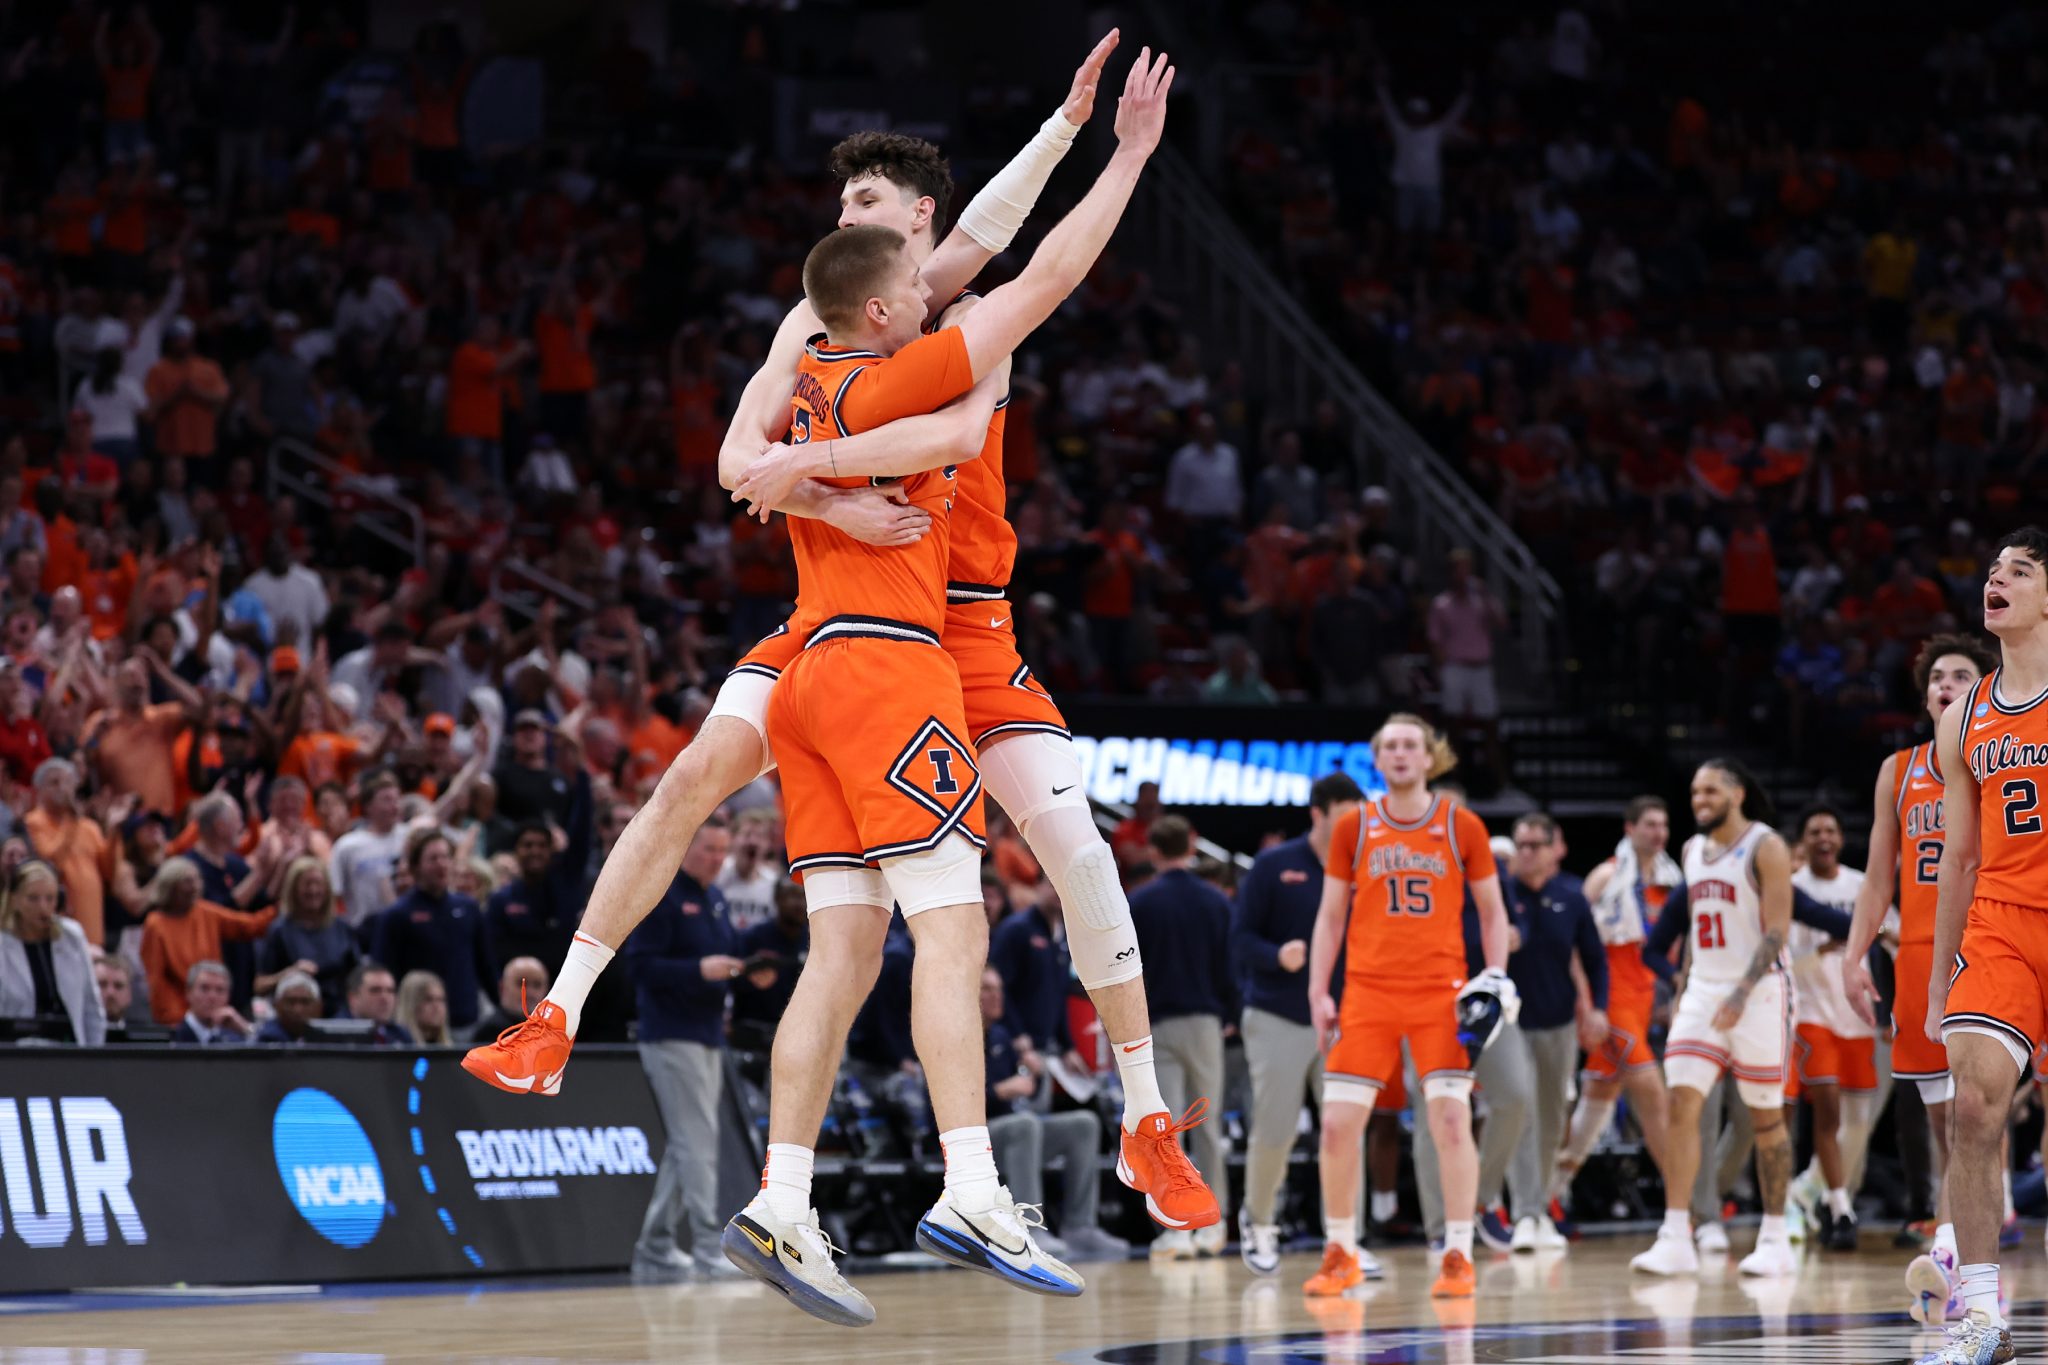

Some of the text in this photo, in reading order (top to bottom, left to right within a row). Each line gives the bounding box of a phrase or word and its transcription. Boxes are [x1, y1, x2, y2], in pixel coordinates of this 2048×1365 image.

[2001, 778, 2042, 836] 2
[1385, 876, 1433, 918] 15
[1697, 912, 1726, 949] 21
[0, 1097, 148, 1248] UR
[455, 1126, 657, 1178] BODYARMOR
[292, 1164, 386, 1207] NCAA
